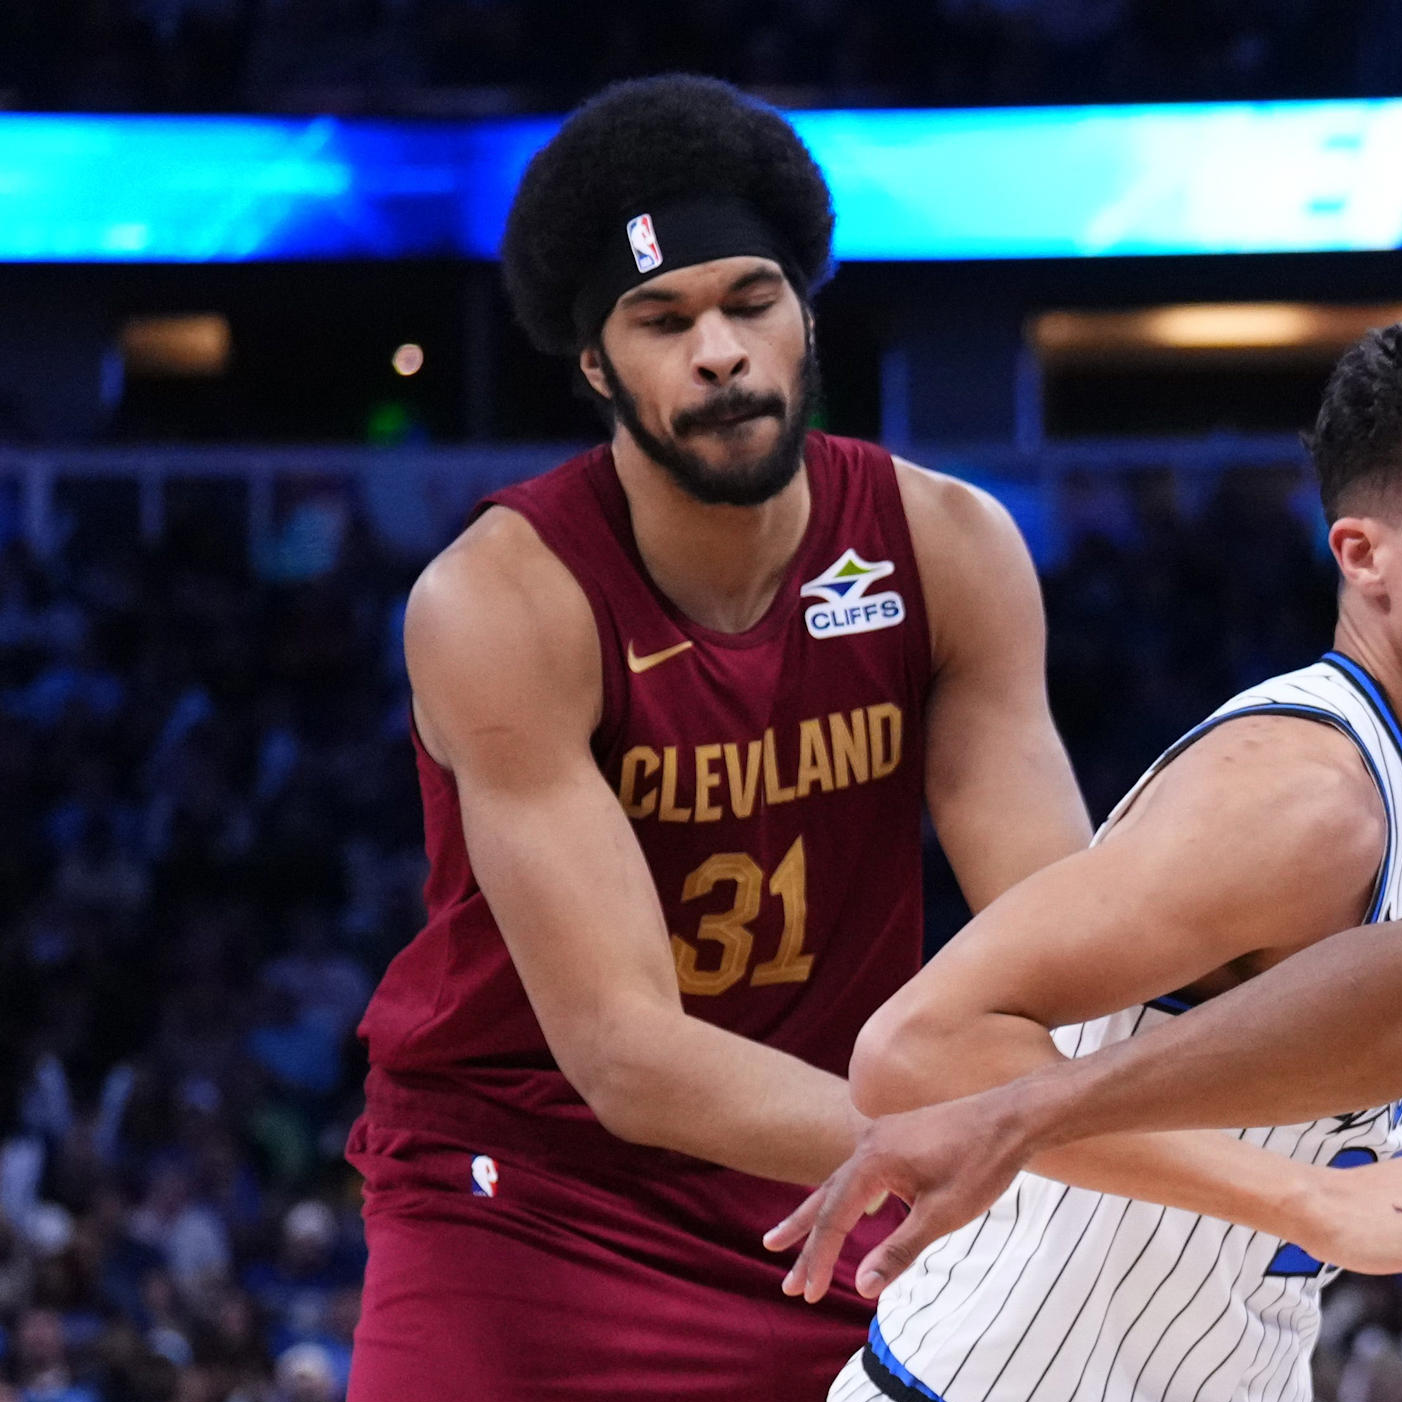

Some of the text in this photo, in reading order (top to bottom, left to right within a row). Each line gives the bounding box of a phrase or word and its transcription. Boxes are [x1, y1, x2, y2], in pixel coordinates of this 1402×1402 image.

[811, 599, 899, 630] CLIFFS
[618, 702, 903, 824] CLEVLAND
[671, 834, 815, 996] 31
